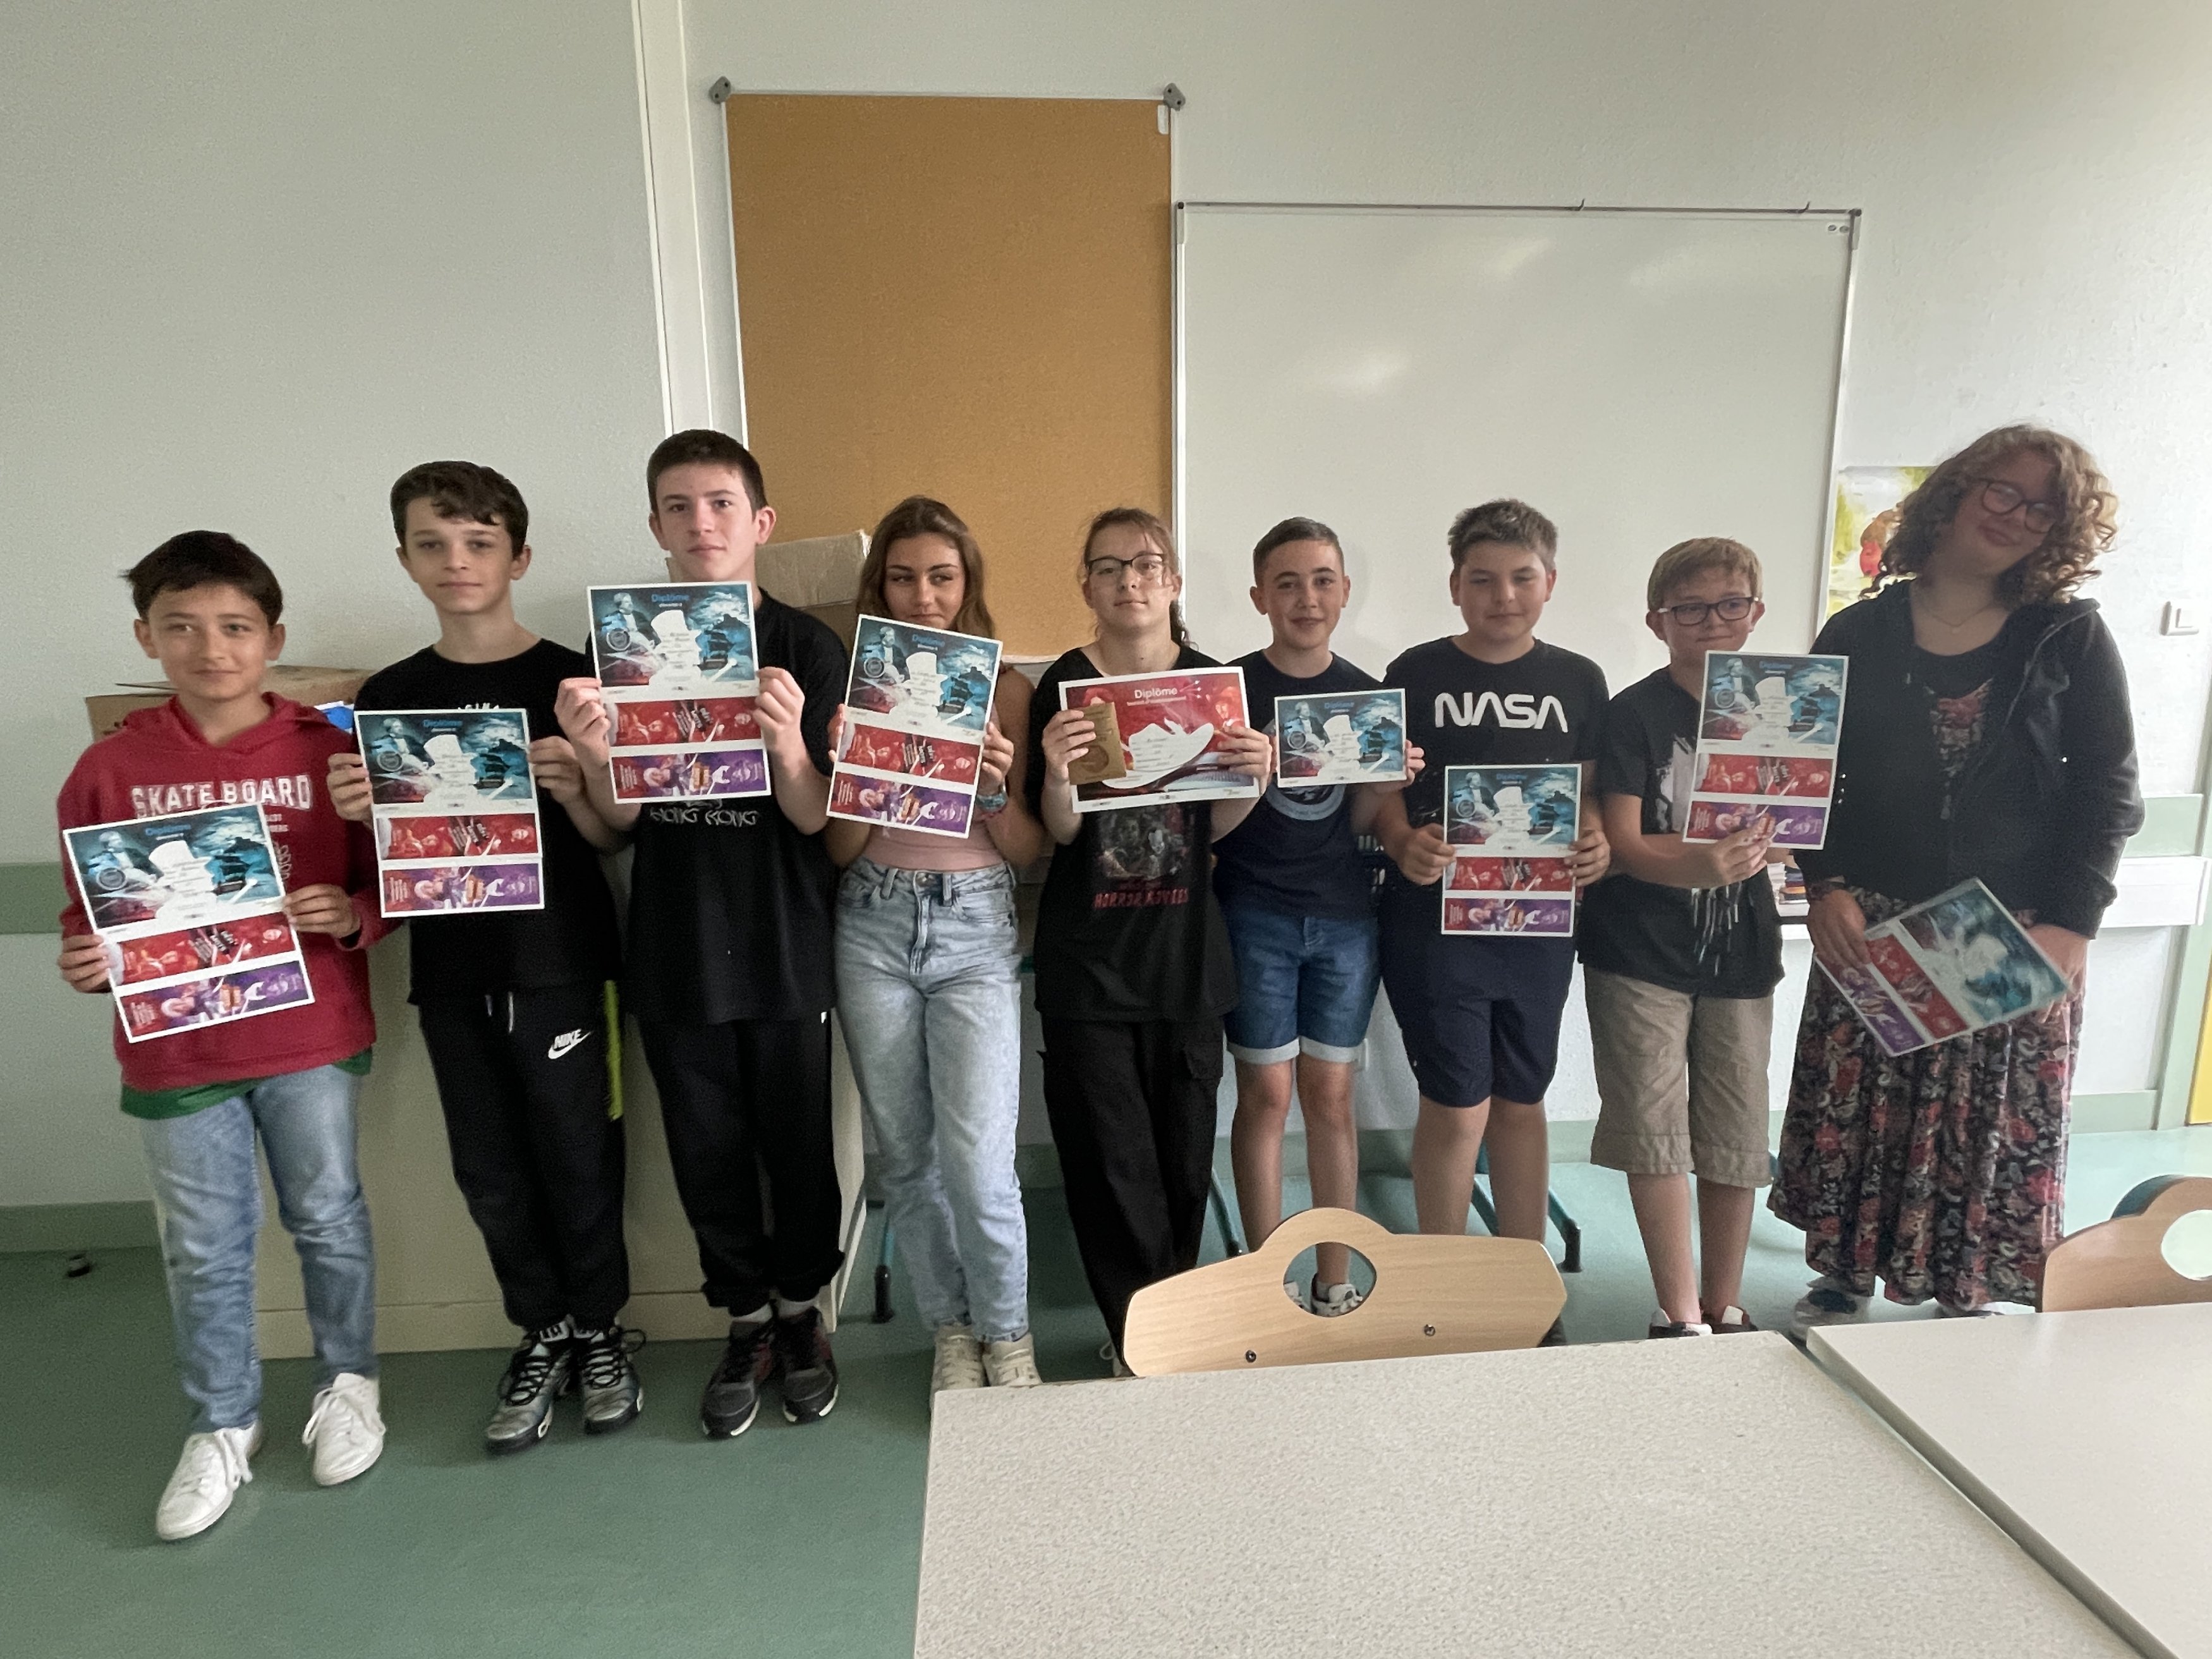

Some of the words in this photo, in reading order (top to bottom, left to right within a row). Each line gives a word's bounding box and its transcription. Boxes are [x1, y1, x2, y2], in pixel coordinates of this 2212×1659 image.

[1134, 687, 1179, 699] Diplôme
[1435, 691, 1569, 733] NASA
[130, 781, 215, 820] SKATE
[221, 774, 313, 811] BOARD
[705, 810, 760, 827] KONG
[553, 1028, 581, 1050] NIKE
